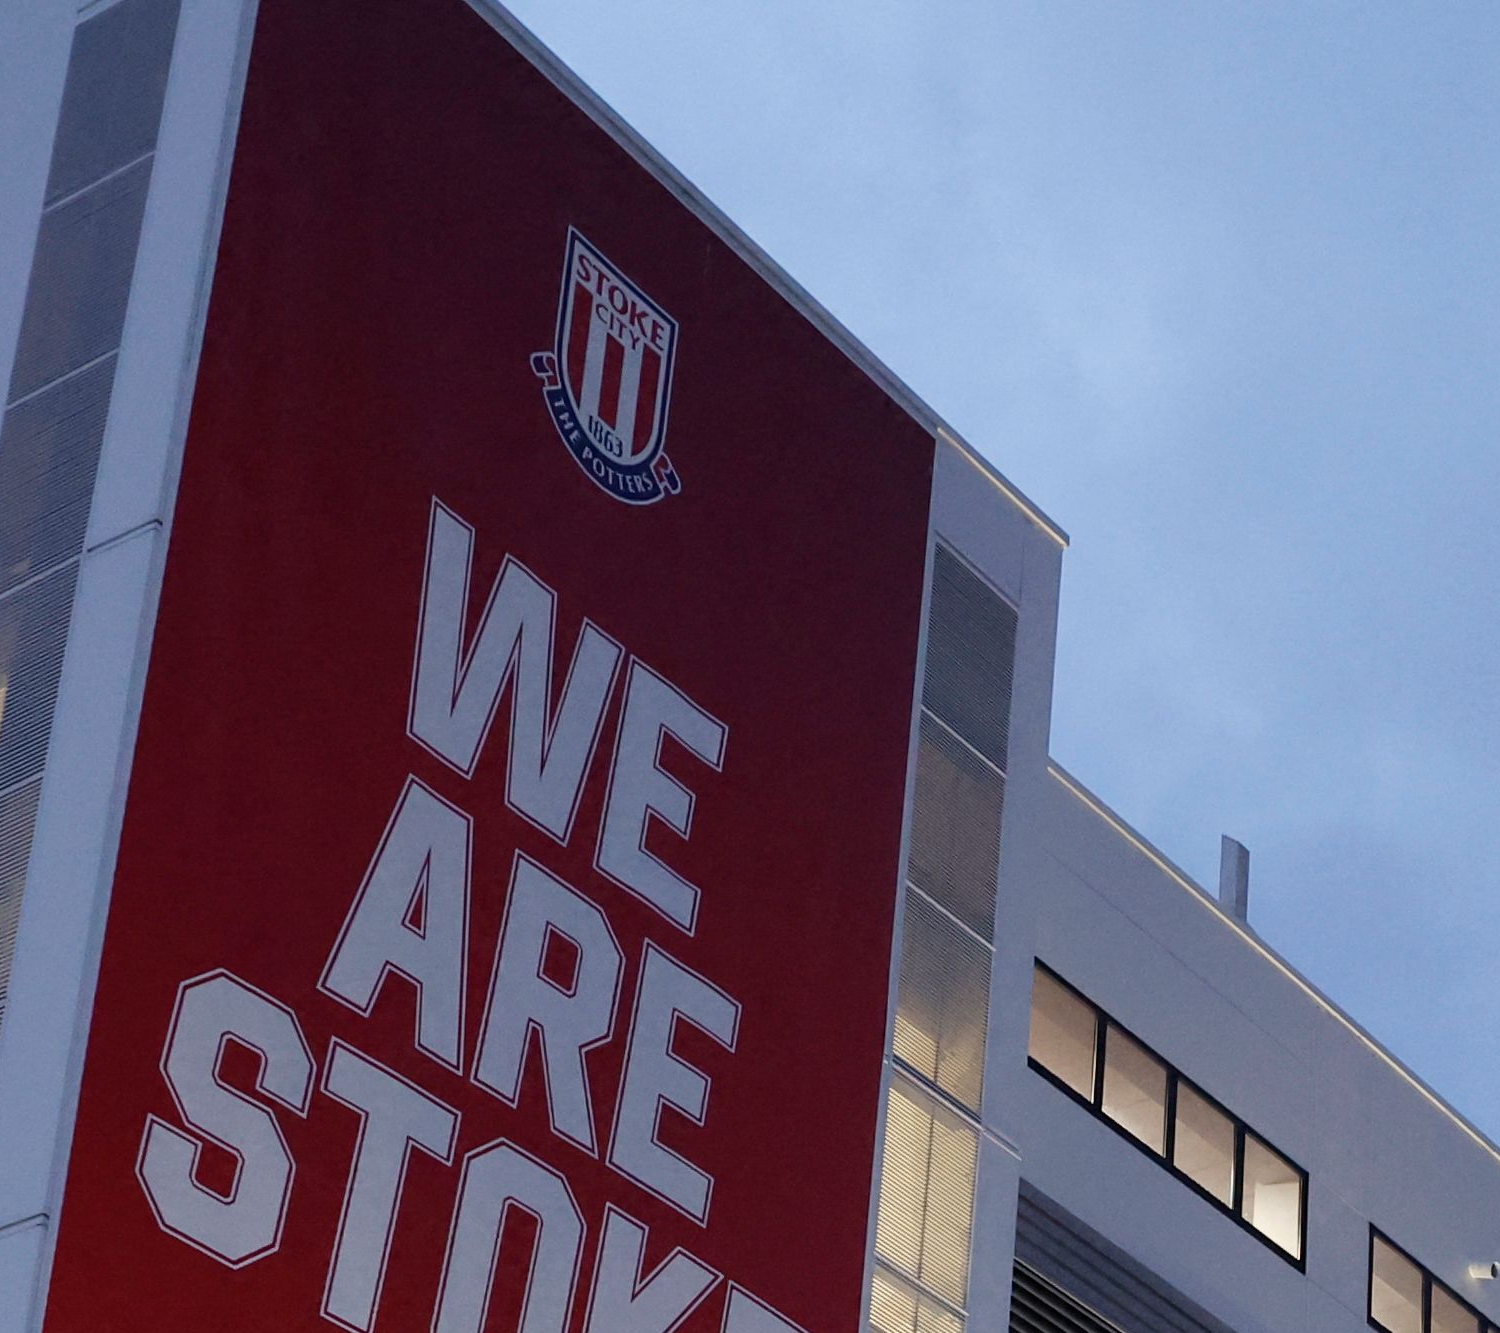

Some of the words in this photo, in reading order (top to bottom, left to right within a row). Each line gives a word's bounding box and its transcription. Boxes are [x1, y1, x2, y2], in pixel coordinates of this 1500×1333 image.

[576, 253, 665, 351] STOKE
[596, 303, 641, 351] CITY
[553, 397, 581, 445] THE
[583, 446, 654, 495] POTTERS
[588, 415, 623, 458] 1863
[406, 496, 729, 937] WE
[318, 773, 742, 1227] ARE
